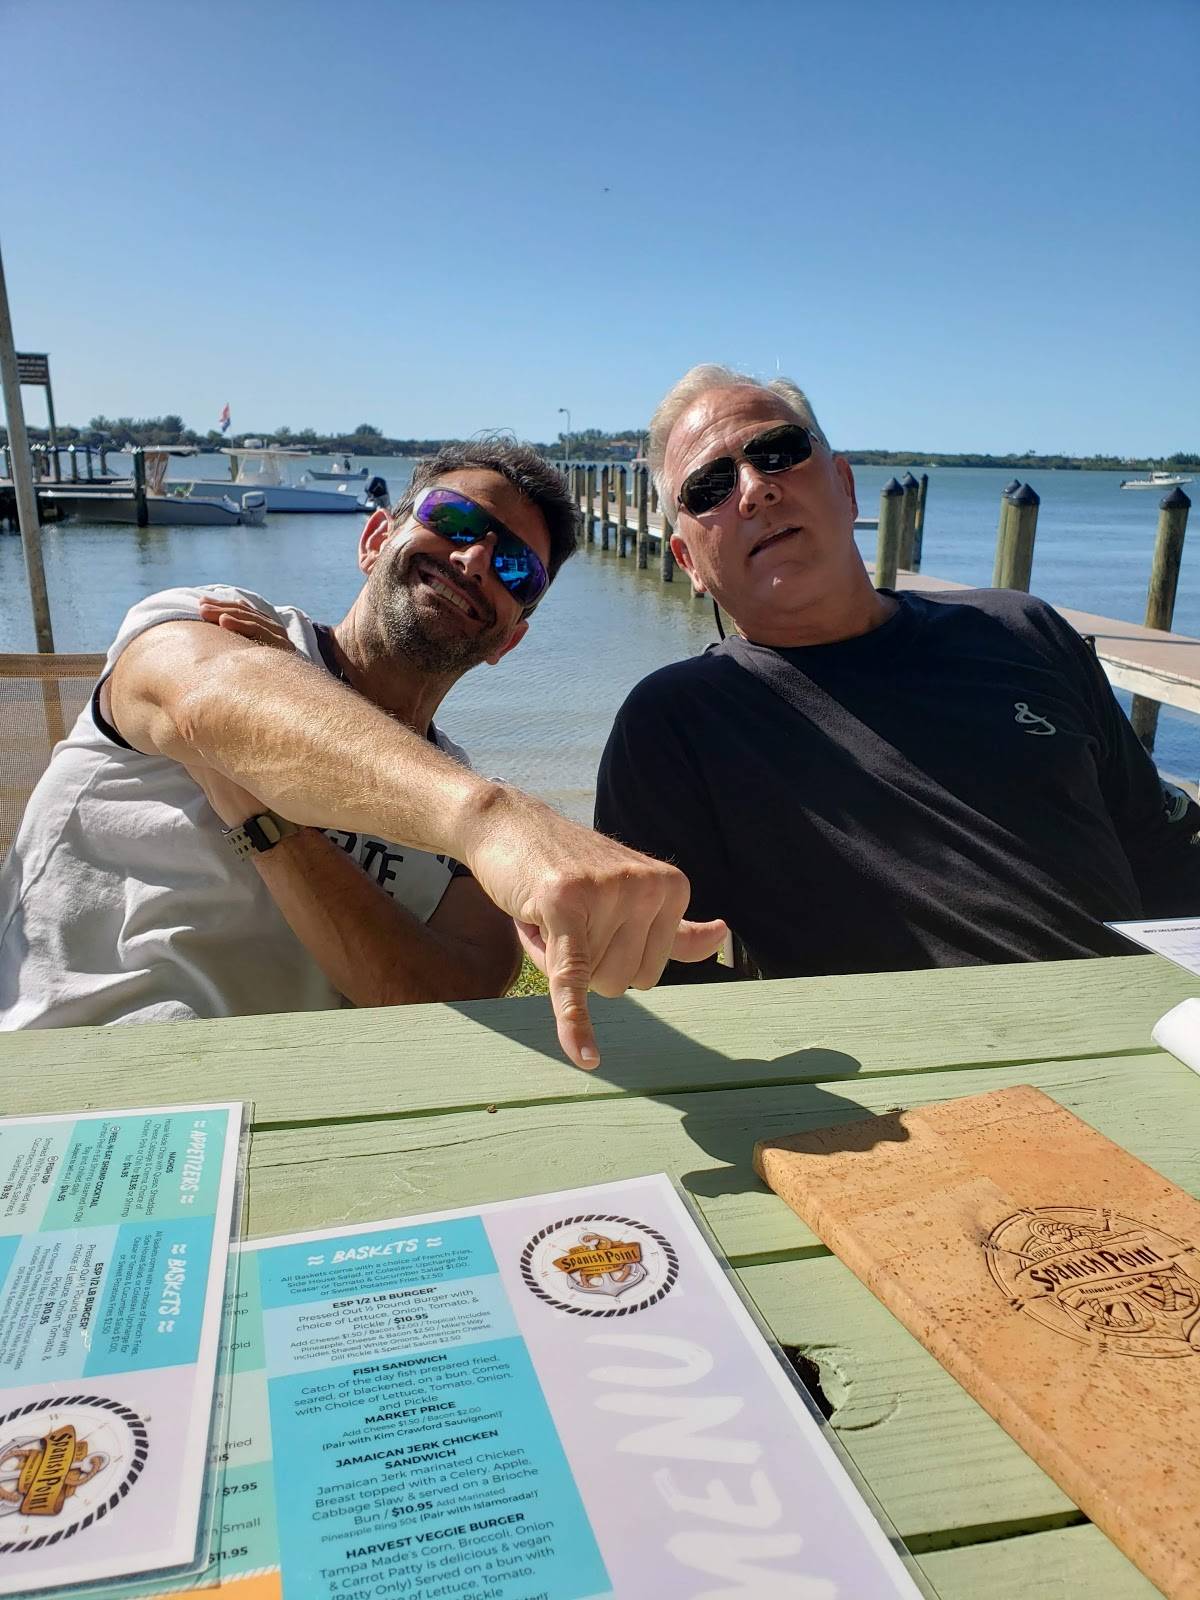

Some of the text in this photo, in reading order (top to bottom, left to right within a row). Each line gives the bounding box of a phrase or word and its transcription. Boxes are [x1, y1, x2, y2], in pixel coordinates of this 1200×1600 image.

[165, 1151, 176, 1173] NACHOS
[178, 1129, 208, 1193] APPETIZERS
[89, 1181, 103, 1207] COCKTAIL
[82, 1244, 96, 1267] Pressed
[330, 1237, 420, 1264] BASKETS
[382, 1258, 410, 1266] choice
[422, 1252, 450, 1260] French
[561, 1252, 604, 1271] Spanish
[605, 1248, 639, 1264] Point
[92, 1262, 103, 1275] ESP
[1030, 1244, 1165, 1293] Spanish Point
[87, 1287, 97, 1296] LB
[156, 1257, 188, 1317] BASKETS
[38, 1301, 54, 1325] $10.95
[298, 1310, 339, 1322] Pressed
[342, 1307, 362, 1315] Out
[376, 1299, 410, 1310] Pound
[413, 1293, 448, 1304] Burger
[450, 1289, 473, 1297] with
[332, 1300, 353, 1309] ESP
[356, 1297, 370, 1305] 1/2
[373, 1294, 386, 1302] LB
[60, 1313, 76, 1338] Burger
[296, 1320, 331, 1331] choice
[353, 1320, 384, 1330] Pickle
[393, 1312, 428, 1324] $10.95
[56, 1339, 69, 1356] with
[353, 1353, 447, 1376] FISH SANDWICH
[294, 1393, 335, 1407] seared,
[353, 1378, 415, 1396] blackened,
[471, 1361, 510, 1374] Comes
[301, 1383, 334, 1395] Catch
[338, 1380, 349, 1388] of
[352, 1376, 371, 1386] the
[374, 1372, 394, 1383] day
[396, 1368, 416, 1378] fish
[419, 1359, 470, 1375] prepared
[295, 1405, 322, 1417] with
[324, 1398, 364, 1411] Choice
[367, 1395, 380, 1403] of
[382, 1386, 426, 1401] Lettuce,
[365, 1400, 456, 1424] MARKET PRICE
[378, 1393, 438, 1411] and Pickle
[225, 1437, 253, 1450] fried
[322, 1440, 345, 1451] (Pair
[348, 1435, 370, 1445] with
[373, 1431, 394, 1440] Kim
[396, 1422, 442, 1436] Crawford
[335, 1428, 498, 1468] JAMAICAN JERK CHICKEN
[316, 1446, 525, 1495] Jamaican Jerk marinated Chicken
[384, 1447, 456, 1470] SANDWICH
[28, 1432, 73, 1511] Spanish Point
[222, 1482, 258, 1497] $7.95
[311, 1501, 370, 1523] Cabbage
[373, 1494, 404, 1508] Slaw
[407, 1492, 415, 1501] &
[418, 1482, 459, 1499] served
[462, 1480, 479, 1489] on
[491, 1466, 539, 1483] Brioche
[315, 1492, 354, 1508] Breast
[358, 1482, 405, 1500] topped
[408, 1475, 436, 1489] with
[436, 1487, 506, 1507] Add Marinated
[320, 1526, 371, 1545] Pineapple
[374, 1520, 397, 1533] Ring
[419, 1510, 445, 1523] (Pair
[447, 1504, 471, 1516] with
[353, 1512, 380, 1525] Bun
[391, 1500, 433, 1517] $10.95
[221, 1517, 262, 1535] Small
[345, 1512, 525, 1559] HARVEST VEGGIE BURGER
[208, 1546, 249, 1565] $11.95
[319, 1560, 368, 1581] Tampa
[371, 1549, 417, 1568] Made's
[514, 1519, 554, 1535] Onion
[329, 1534, 552, 1592] & Carrot Patty is delicious & vegan
[375, 1578, 412, 1597] Only)
[415, 1567, 460, 1586] Served
[463, 1564, 481, 1575] on
[495, 1553, 523, 1568] bun
[525, 1546, 555, 1561] with
[408, 1590, 423, 1600] of
[462, 1586, 503, 1600] Pickle
